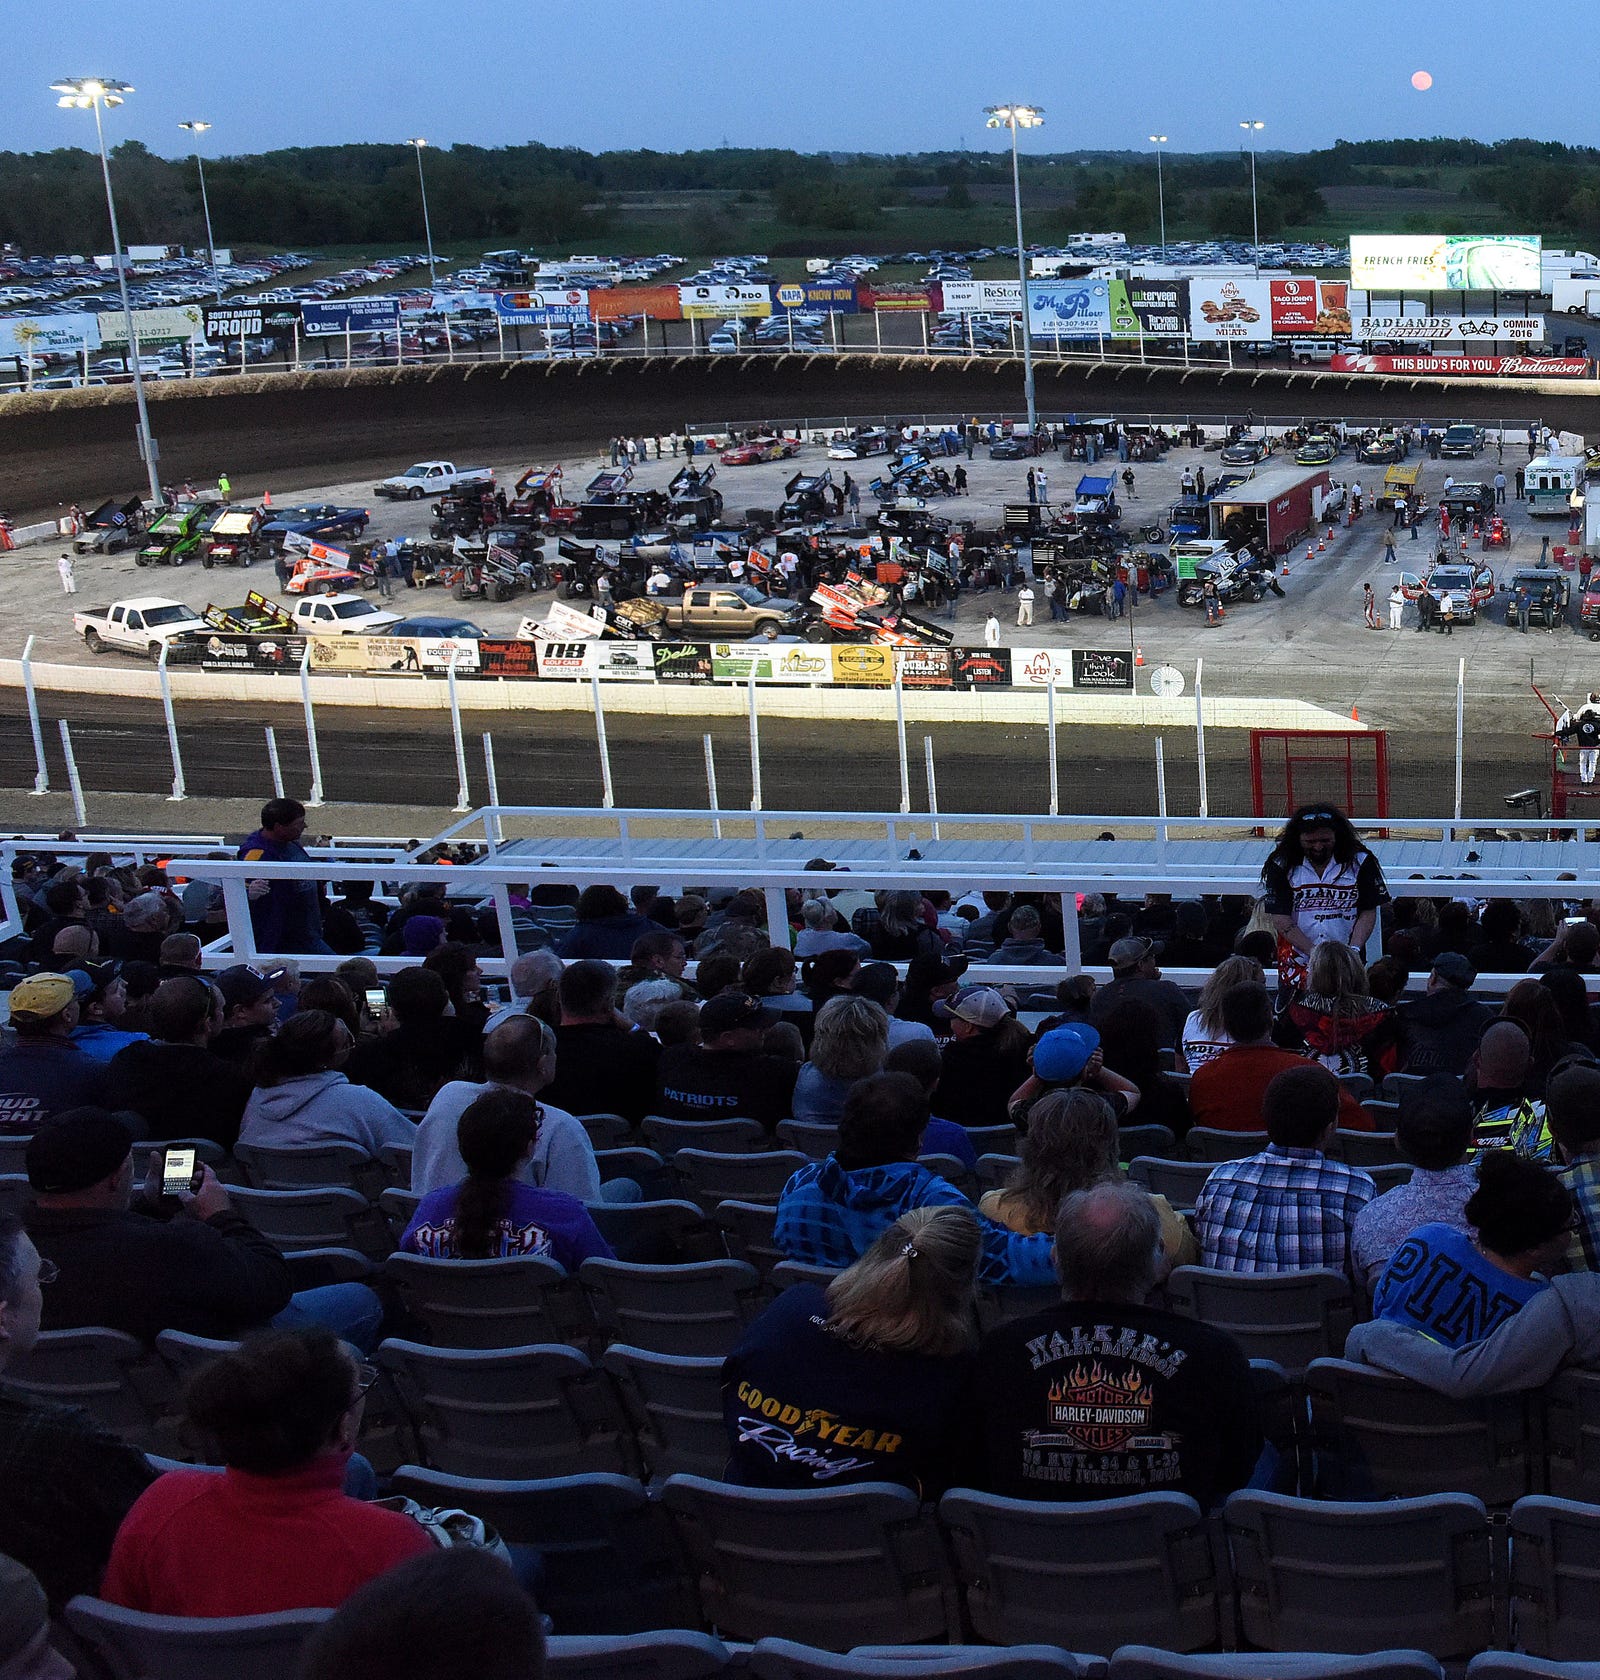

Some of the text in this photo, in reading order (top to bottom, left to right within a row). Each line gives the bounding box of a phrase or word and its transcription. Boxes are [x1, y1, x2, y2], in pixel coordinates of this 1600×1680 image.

[1364, 256, 1434, 265] FRENCH FRIES
[781, 289, 802, 300] NAPA
[808, 289, 851, 300] KNOW HOW
[1220, 288, 1240, 296] Arby's
[208, 309, 261, 319] SOUTH DAKOTA
[501, 315, 534, 325] CENTRAL
[575, 314, 587, 322] AIR
[207, 318, 262, 337] PROUD
[1361, 318, 1539, 329] BADLANDS COMING
[1215, 328, 1248, 336] MEATS
[1386, 328, 1454, 337] SPEEDWAY
[1509, 329, 1533, 338] 2016
[1392, 357, 1585, 375] THIS BUD'S FOR YOU. Budweiser
[1084, 666, 1115, 678] Look
[664, 1086, 739, 1107] PATRIOTS
[1025, 1324, 1188, 1367] WALKER'S
[1029, 1340, 1180, 1380] HARLEY-DAVIDSON
[1076, 1391, 1125, 1404] MOTOR
[1055, 1406, 1145, 1424] HARLEY-DAVIDSON
[1075, 1427, 1124, 1446] CYCLES
[737, 1415, 874, 1480] Racing
